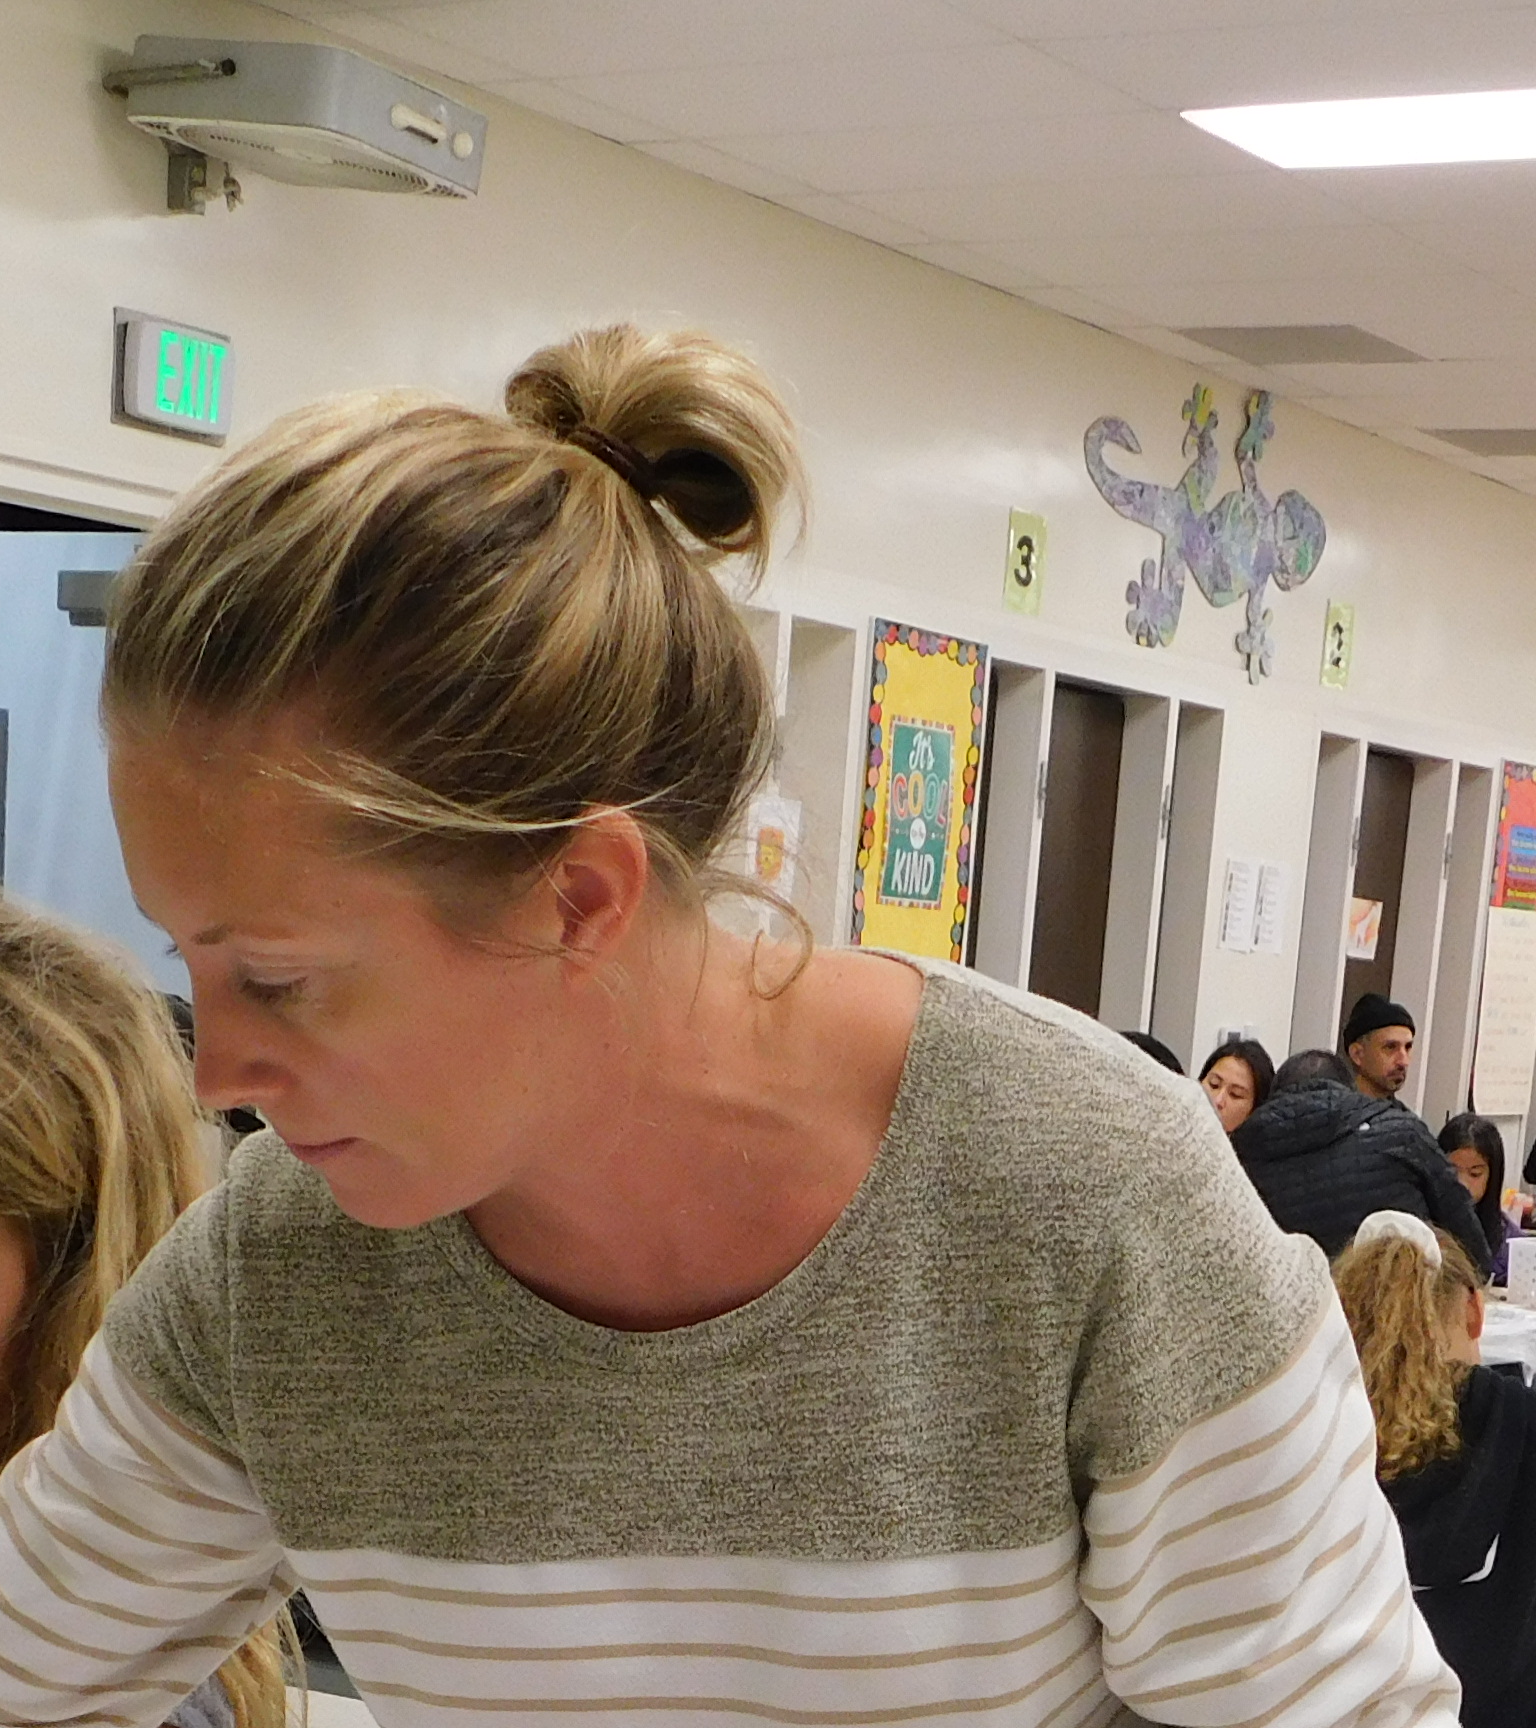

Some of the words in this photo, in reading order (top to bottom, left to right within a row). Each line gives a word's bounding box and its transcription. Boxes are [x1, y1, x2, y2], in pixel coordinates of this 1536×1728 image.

[156, 329, 227, 425] EXIT
[1012, 534, 1035, 588] 3
[909, 731, 935, 771] It's
[892, 770, 948, 829] COOL
[891, 846, 935, 896] KIND
